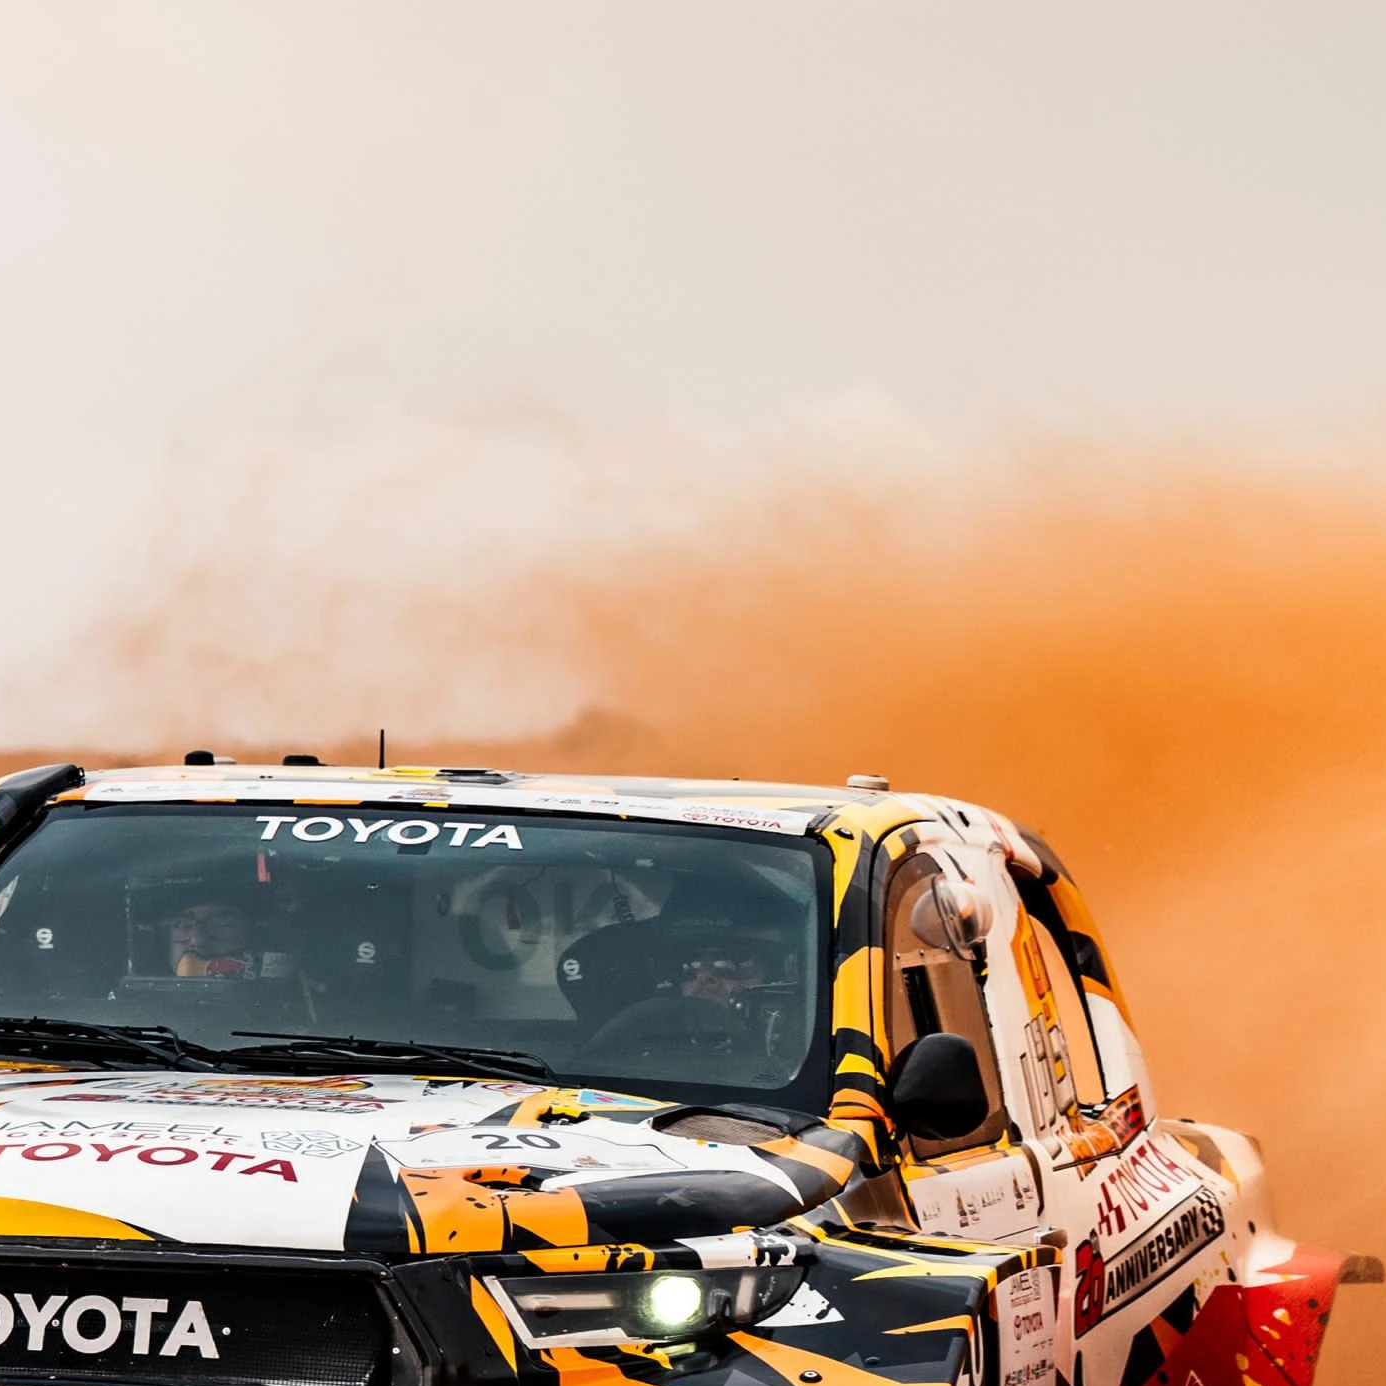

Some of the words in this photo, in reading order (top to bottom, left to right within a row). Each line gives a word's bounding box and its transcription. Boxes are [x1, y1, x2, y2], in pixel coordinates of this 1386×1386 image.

[256, 815, 524, 850] TOYOTA
[471, 1134, 561, 1150] 20
[1108, 1138, 1192, 1222] TOYOTA
[1105, 1206, 1199, 1305] ANNIVERSARY
